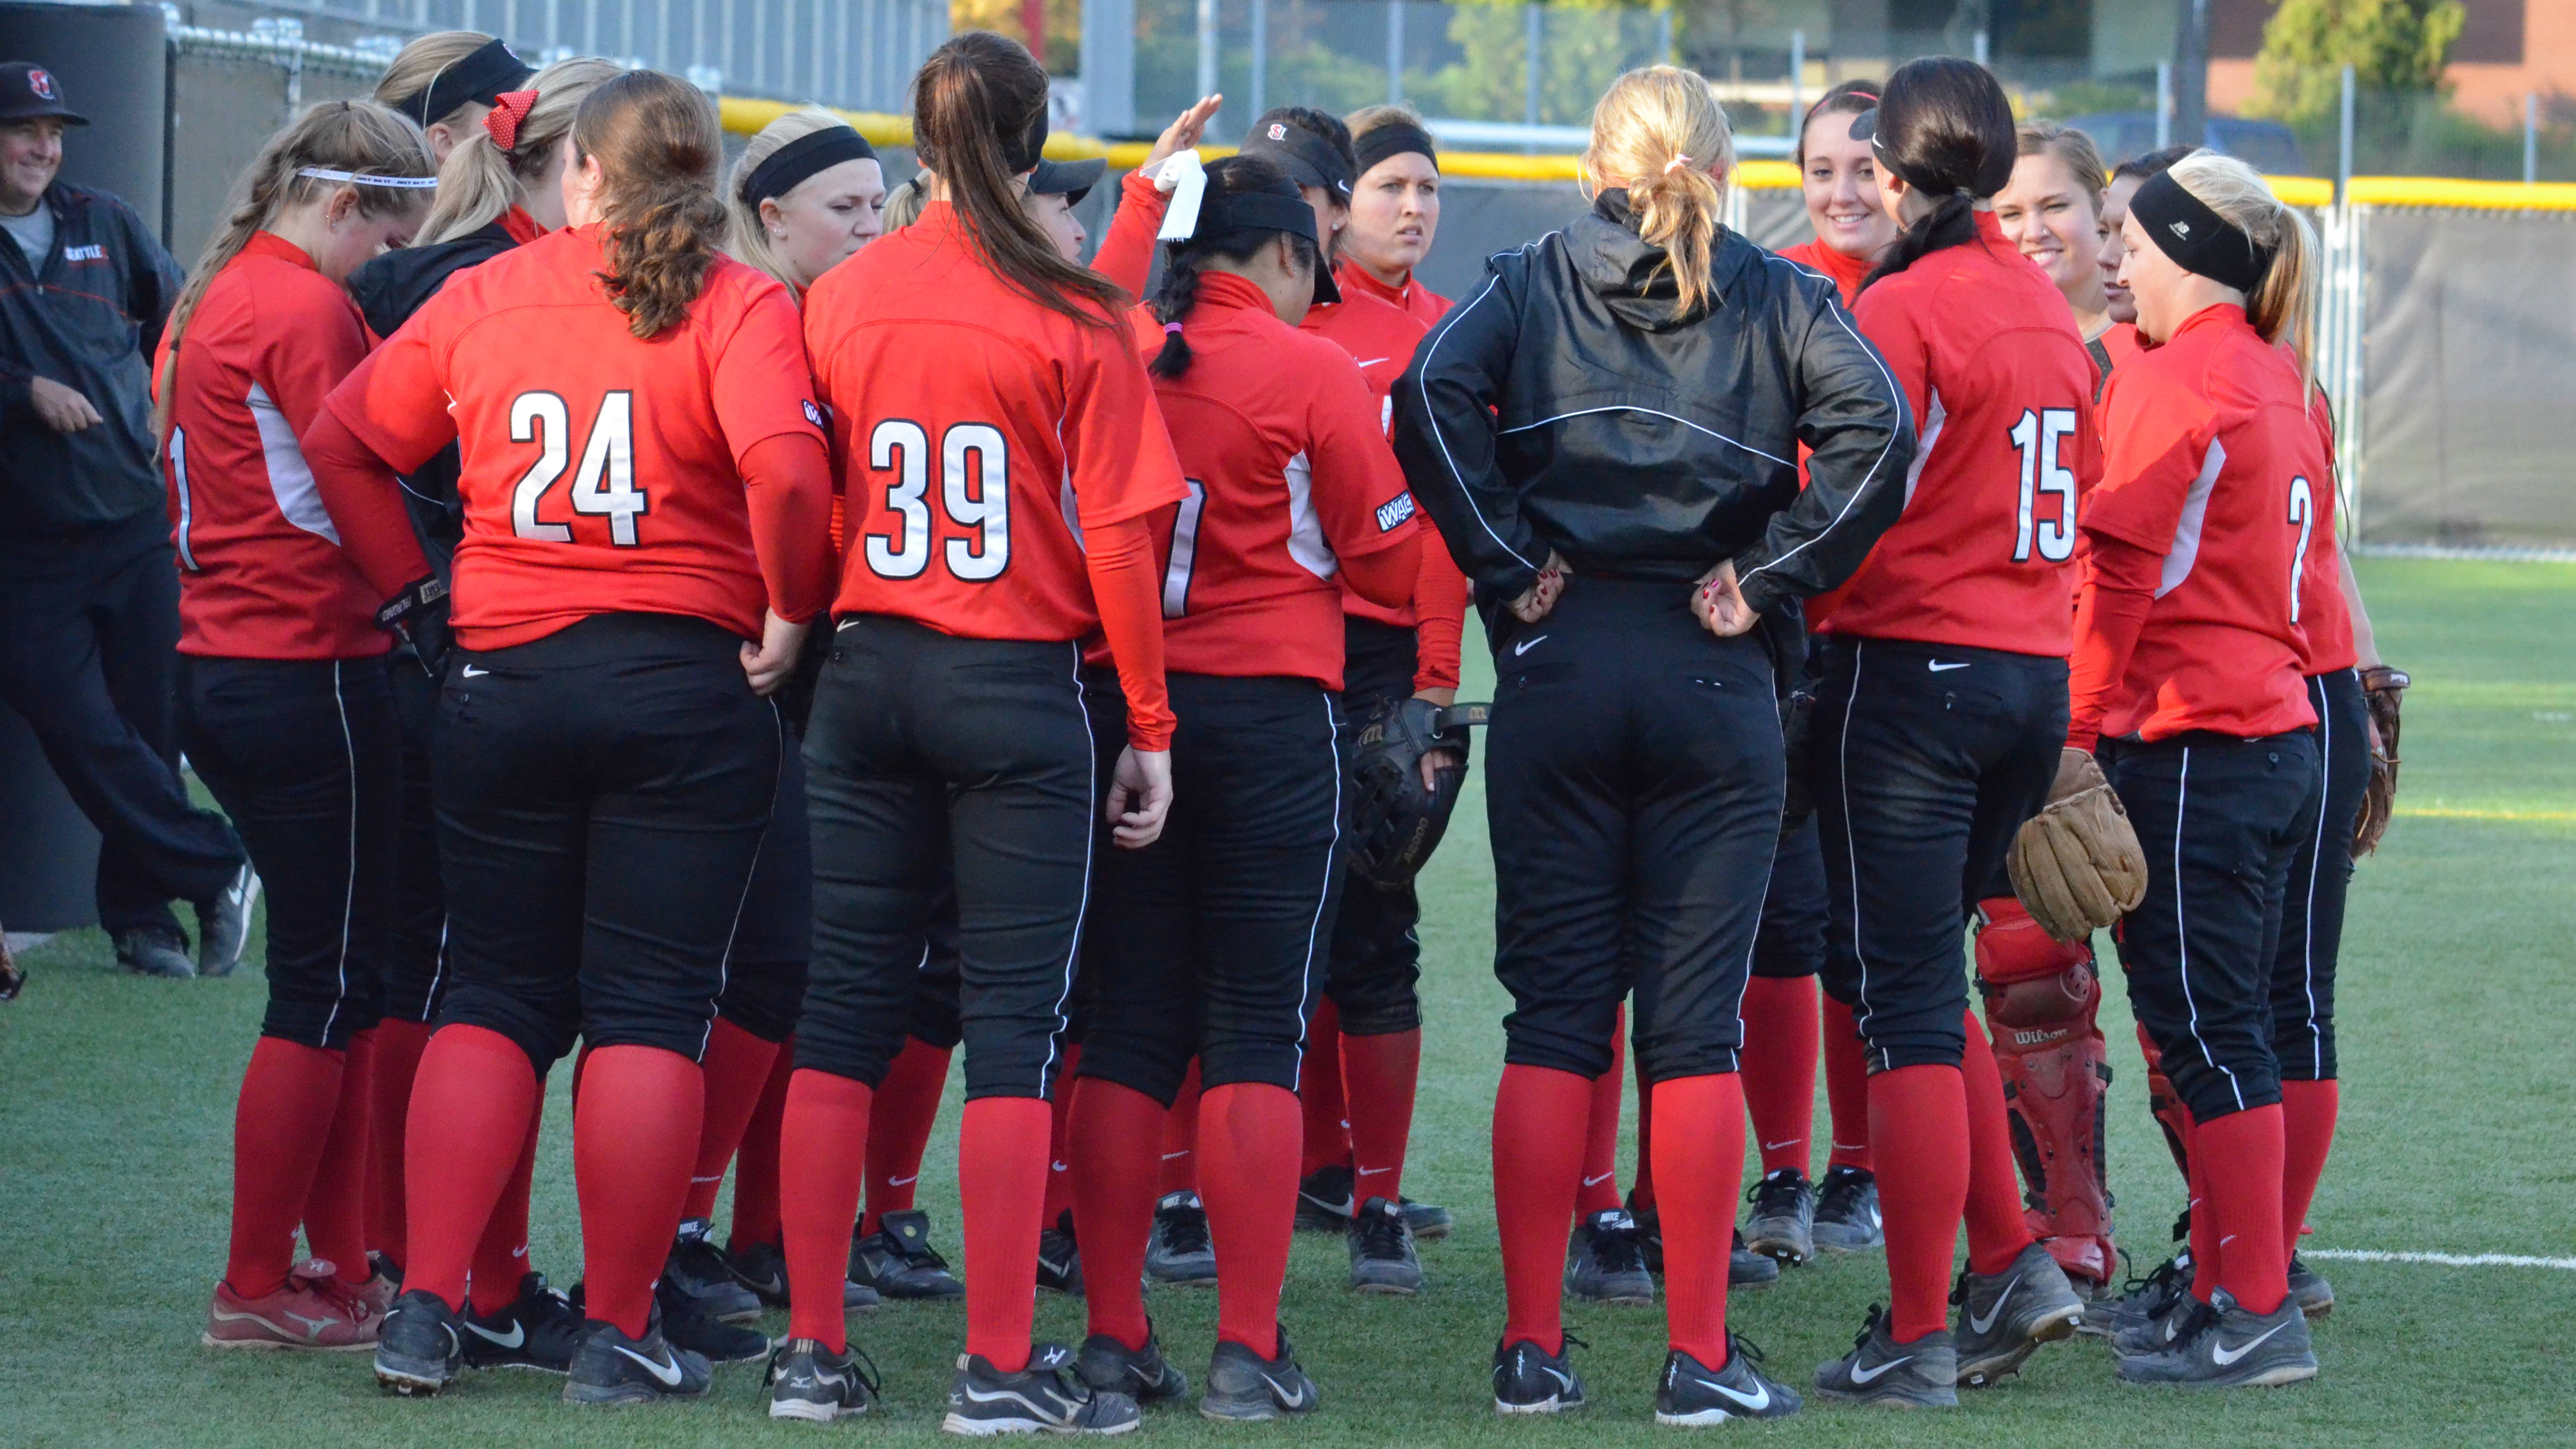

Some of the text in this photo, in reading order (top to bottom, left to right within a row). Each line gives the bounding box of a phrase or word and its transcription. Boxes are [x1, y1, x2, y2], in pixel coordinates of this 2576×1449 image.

[509, 390, 648, 546] 24
[865, 419, 1011, 583] 39
[1379, 492, 1415, 528] WAC
[2008, 407, 2076, 562] 15
[2287, 475, 2313, 626] 2
[2014, 1029, 2067, 1044] Wilson
[678, 1221, 698, 1235] NIKE
[1600, 1212, 1620, 1223] NIKE
